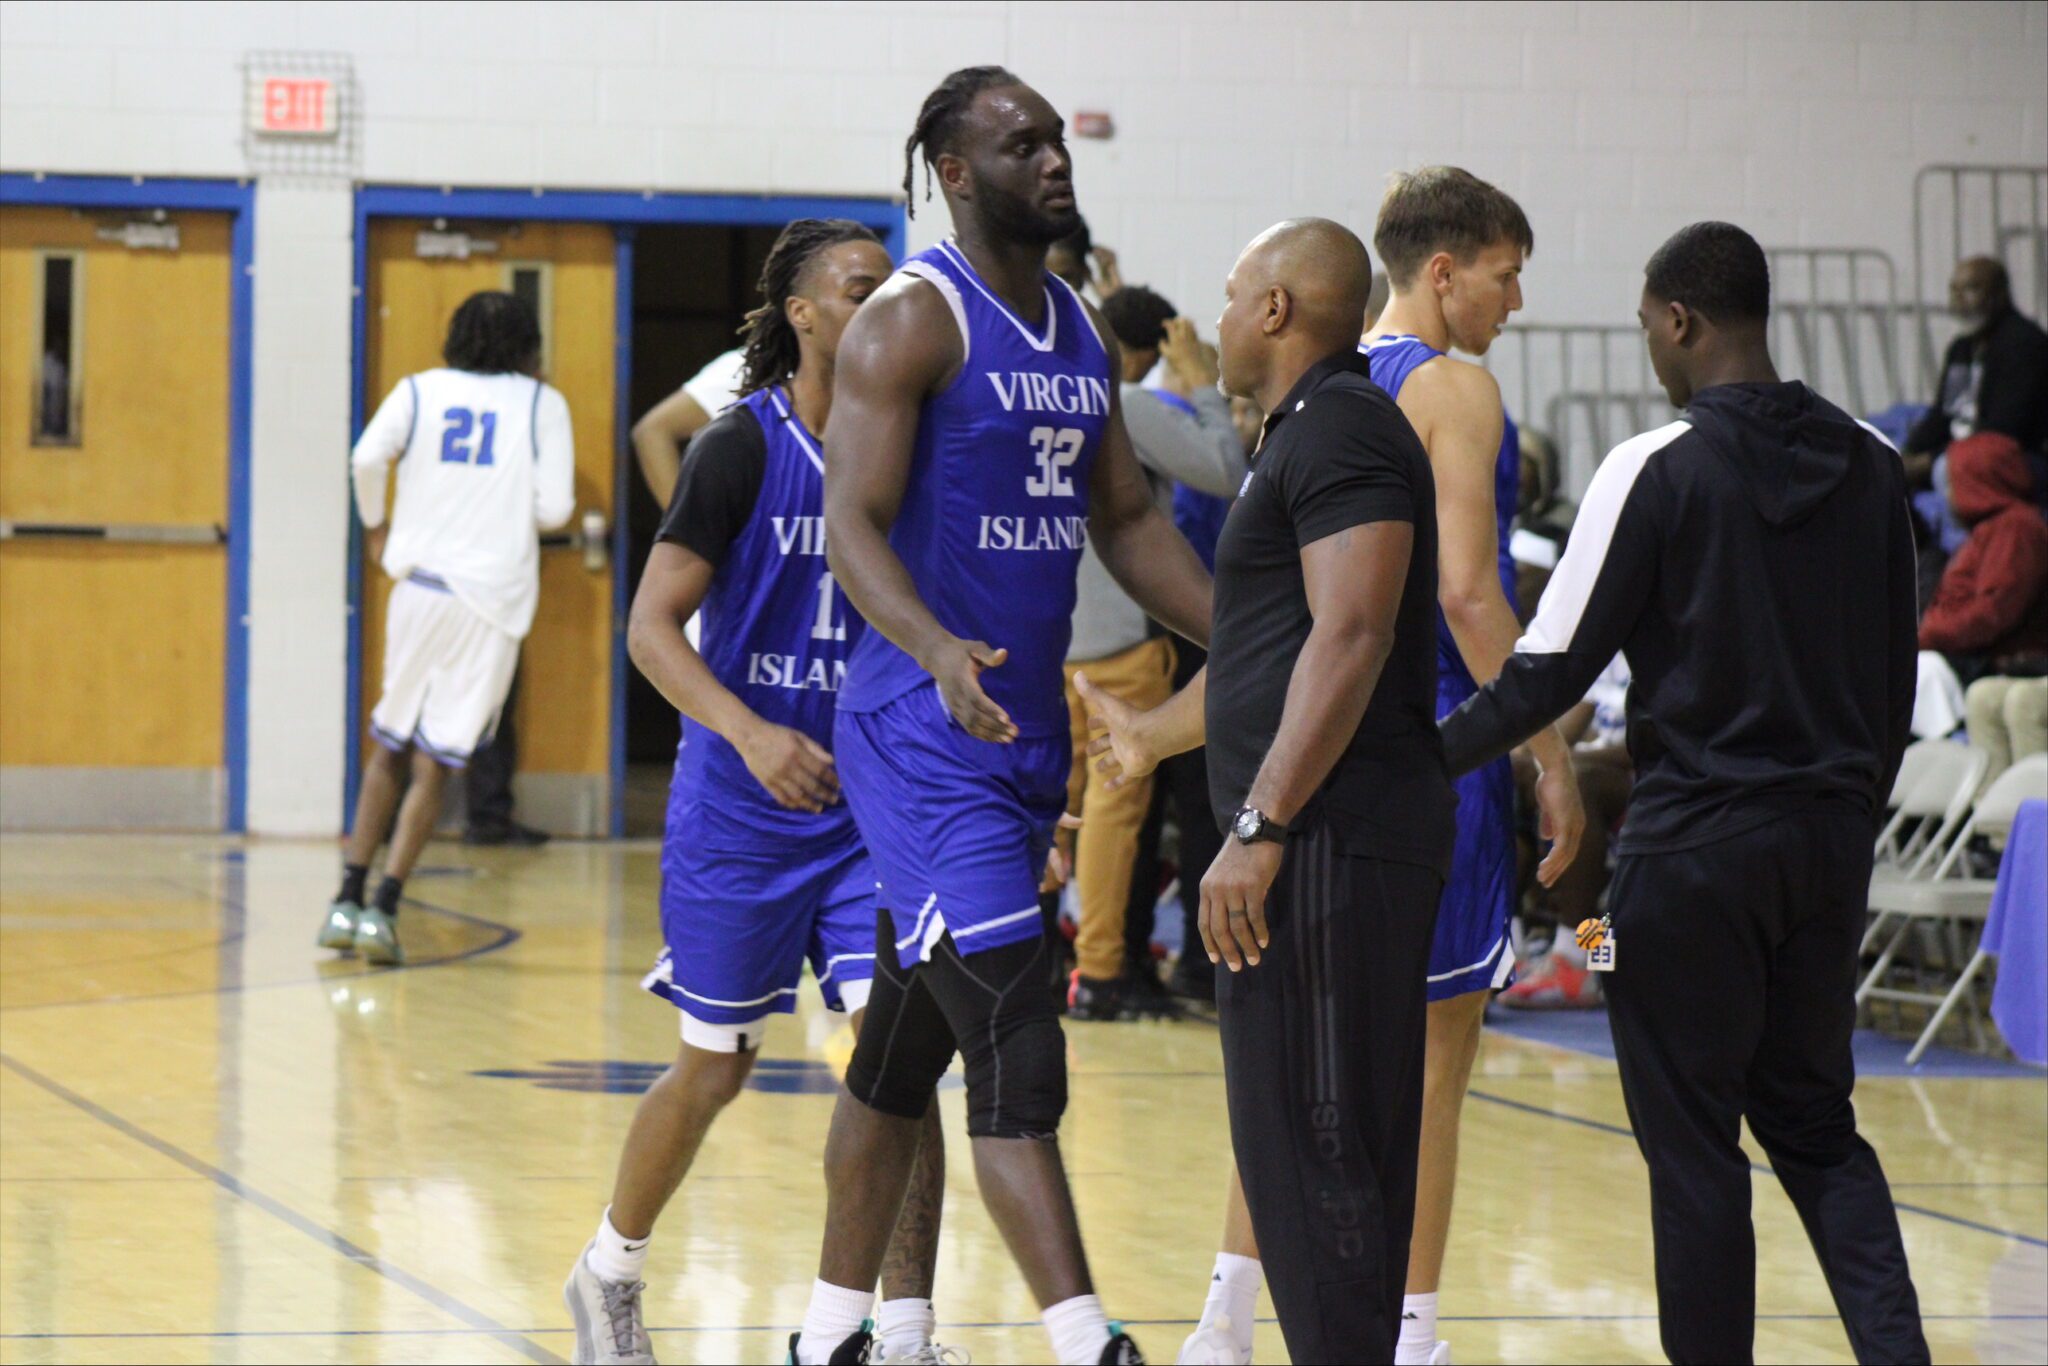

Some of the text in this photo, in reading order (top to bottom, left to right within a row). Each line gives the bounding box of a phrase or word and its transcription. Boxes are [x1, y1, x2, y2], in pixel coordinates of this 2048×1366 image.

[265, 79, 330, 131] EXIT
[985, 372, 1110, 416] VIRGIN
[441, 407, 496, 465] 21
[1025, 426, 1085, 497] 32
[1591, 945, 1611, 963] 23
